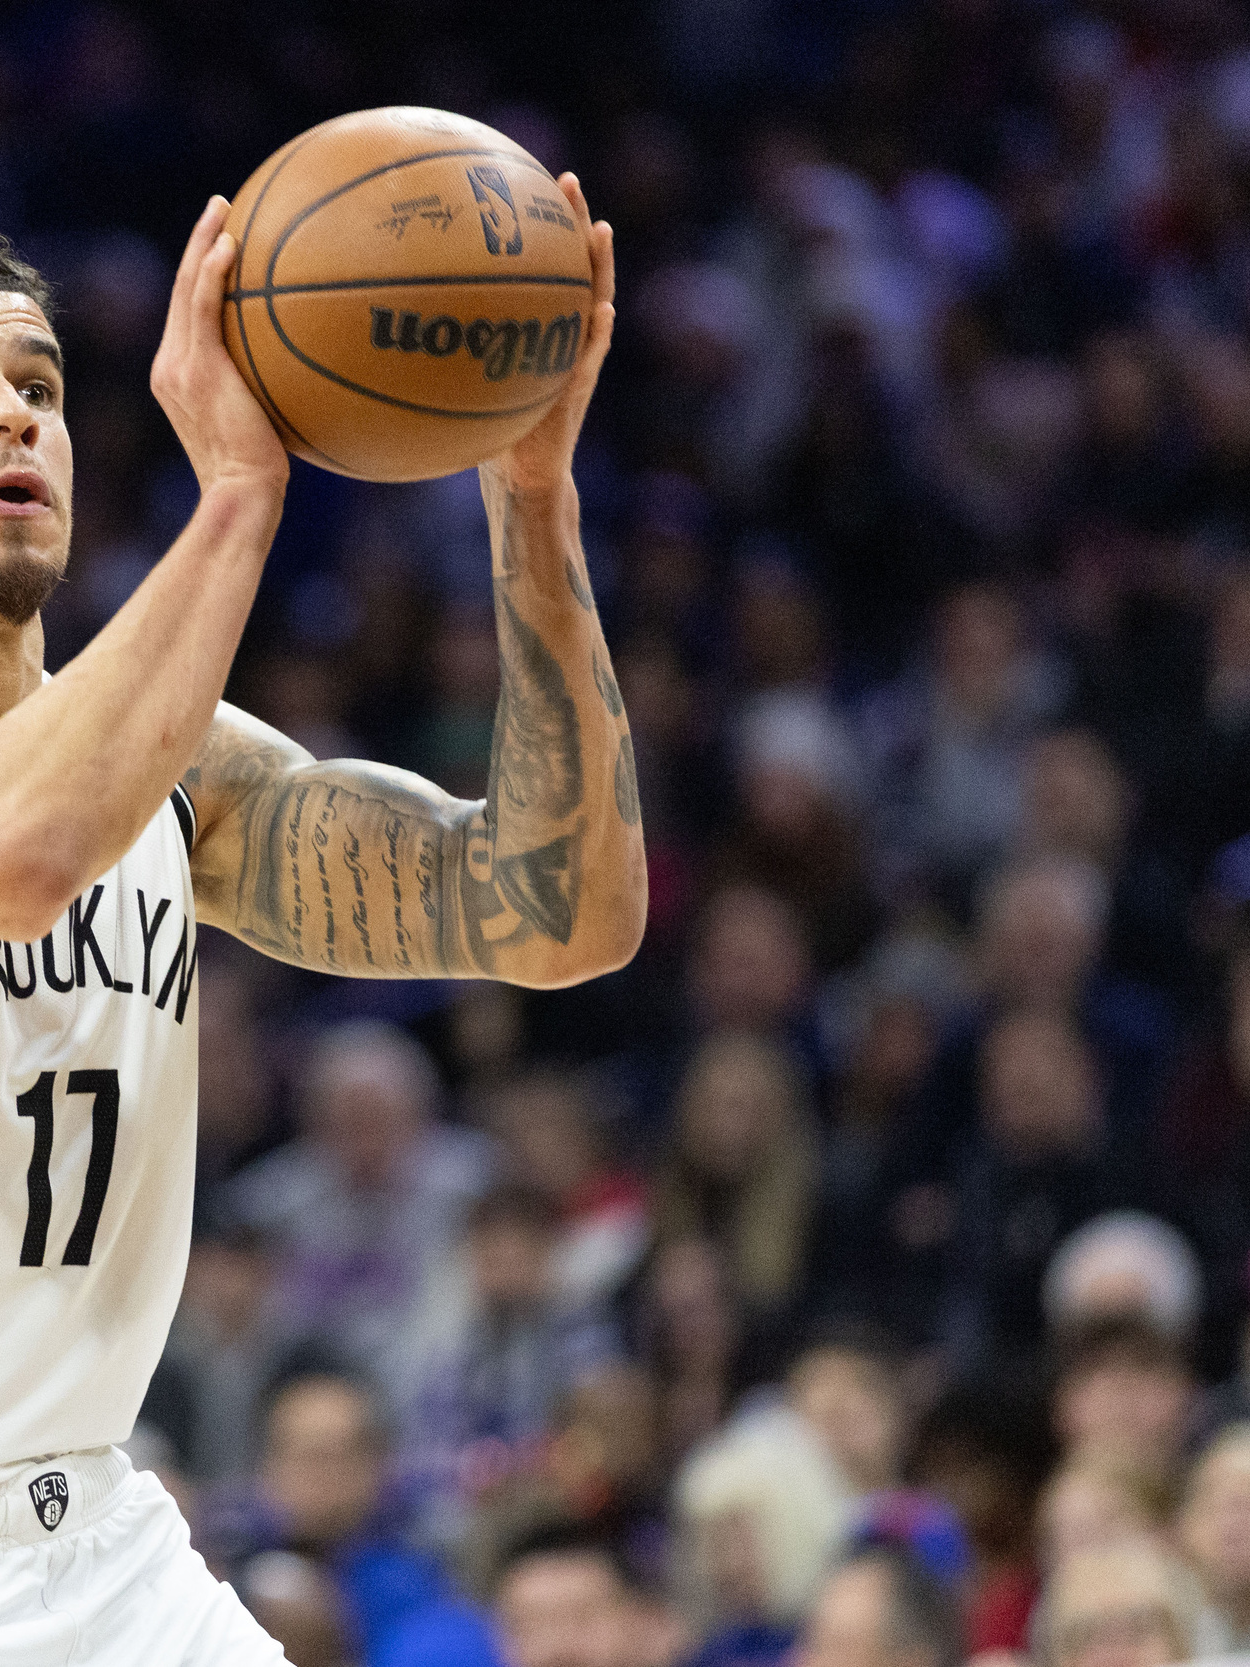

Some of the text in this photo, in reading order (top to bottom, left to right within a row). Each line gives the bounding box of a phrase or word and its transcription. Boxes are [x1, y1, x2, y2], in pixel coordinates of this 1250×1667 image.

[369, 305, 583, 383] Wilson
[16, 1069, 120, 1267] 17
[32, 1475, 67, 1505] NETS
